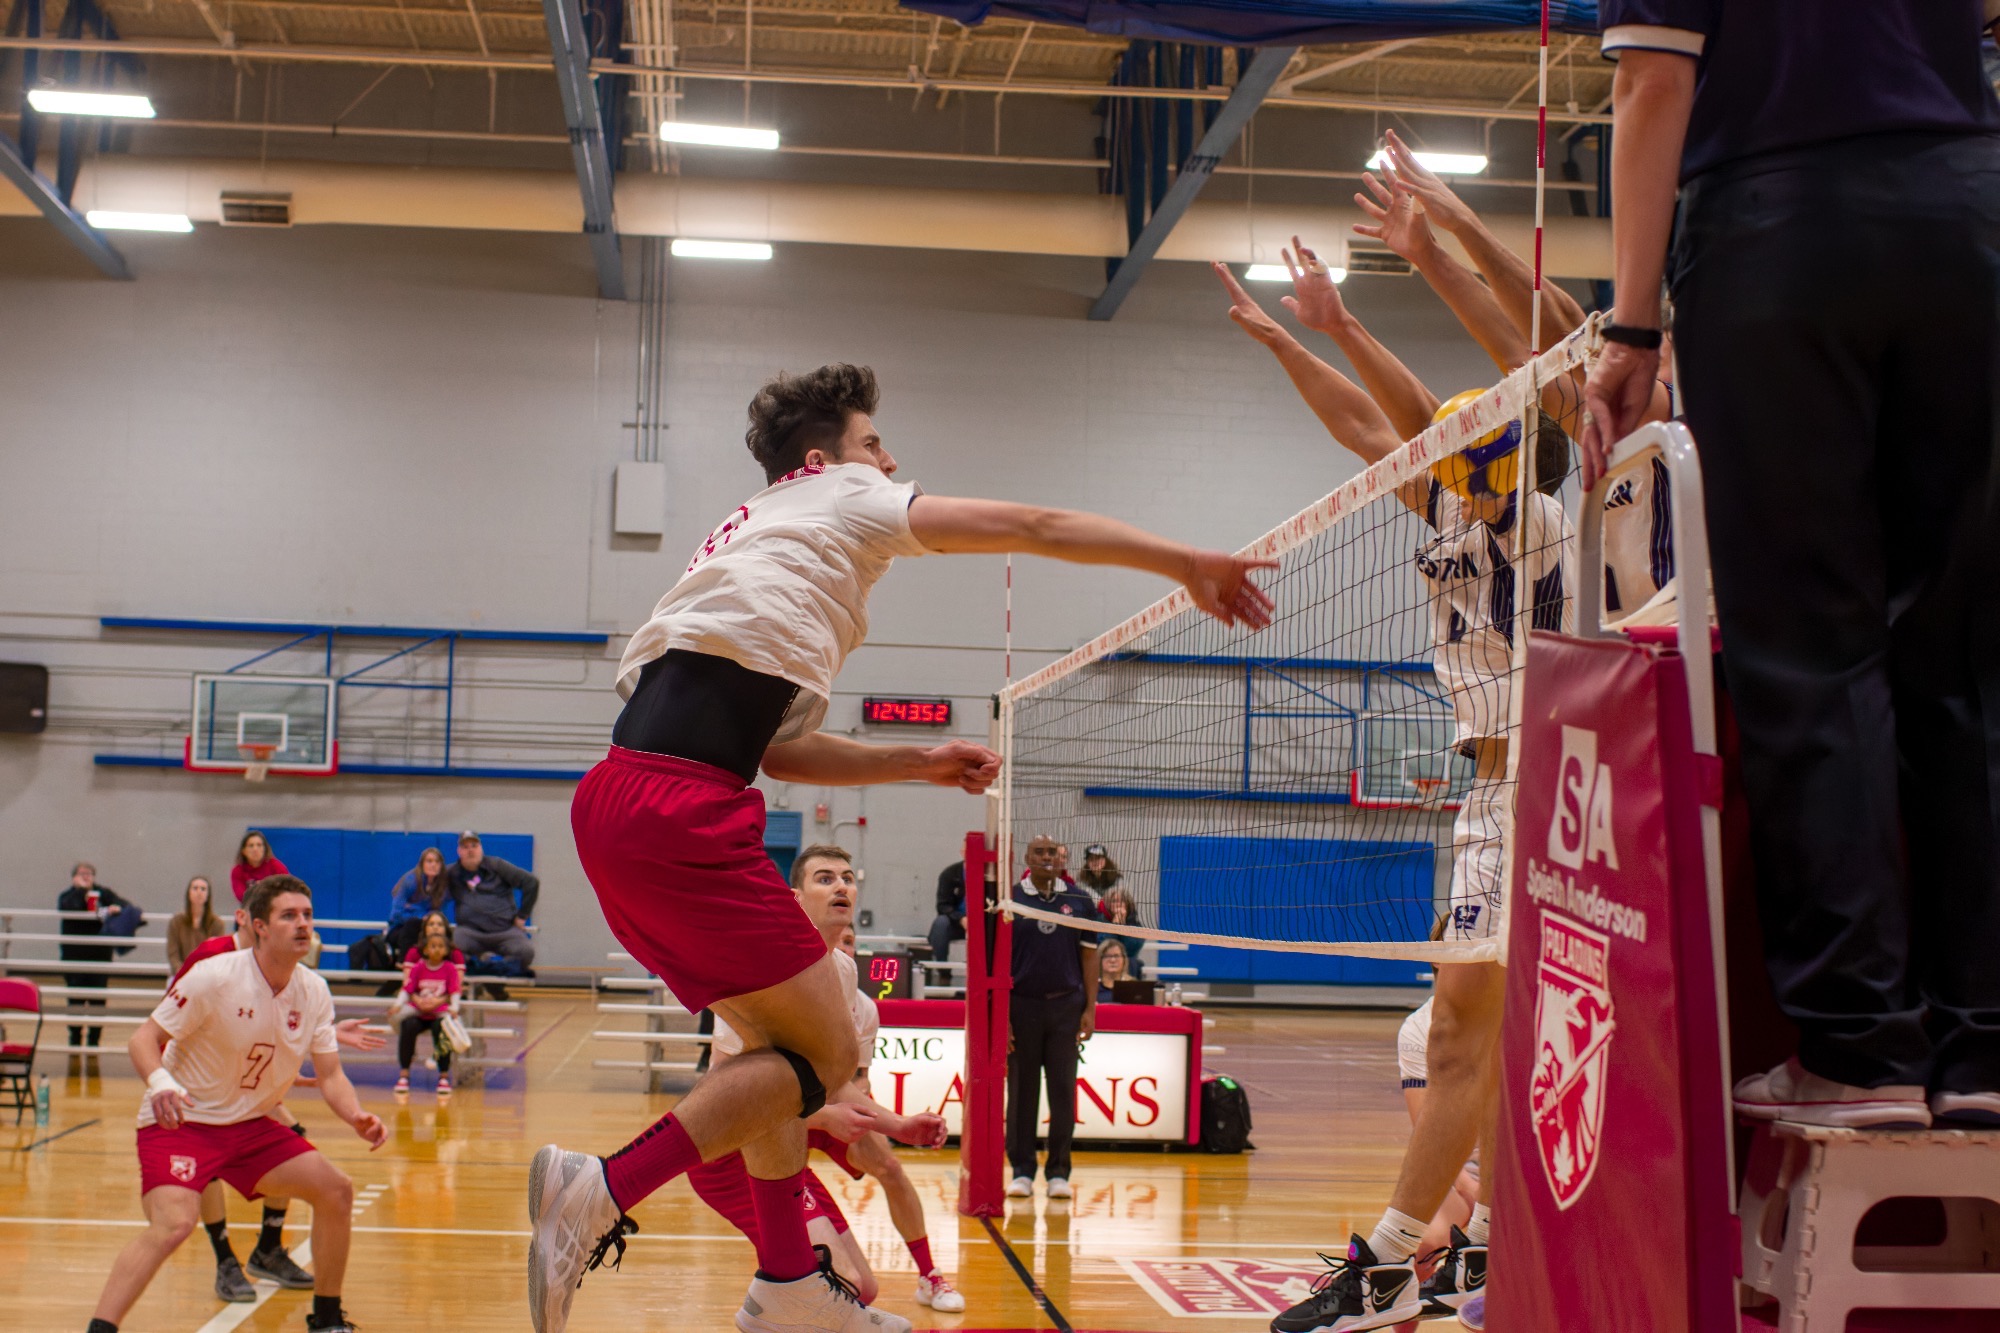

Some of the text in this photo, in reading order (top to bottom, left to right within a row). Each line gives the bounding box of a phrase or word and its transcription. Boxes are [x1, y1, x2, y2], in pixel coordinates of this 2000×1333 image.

[1555, 748, 1619, 871] SA
[1567, 876, 1647, 944] Anderson
[870, 957, 899, 981] 00
[1545, 925, 1603, 982] PALADINS
[240, 1043, 275, 1090] 7
[872, 1036, 944, 1062] RMC
